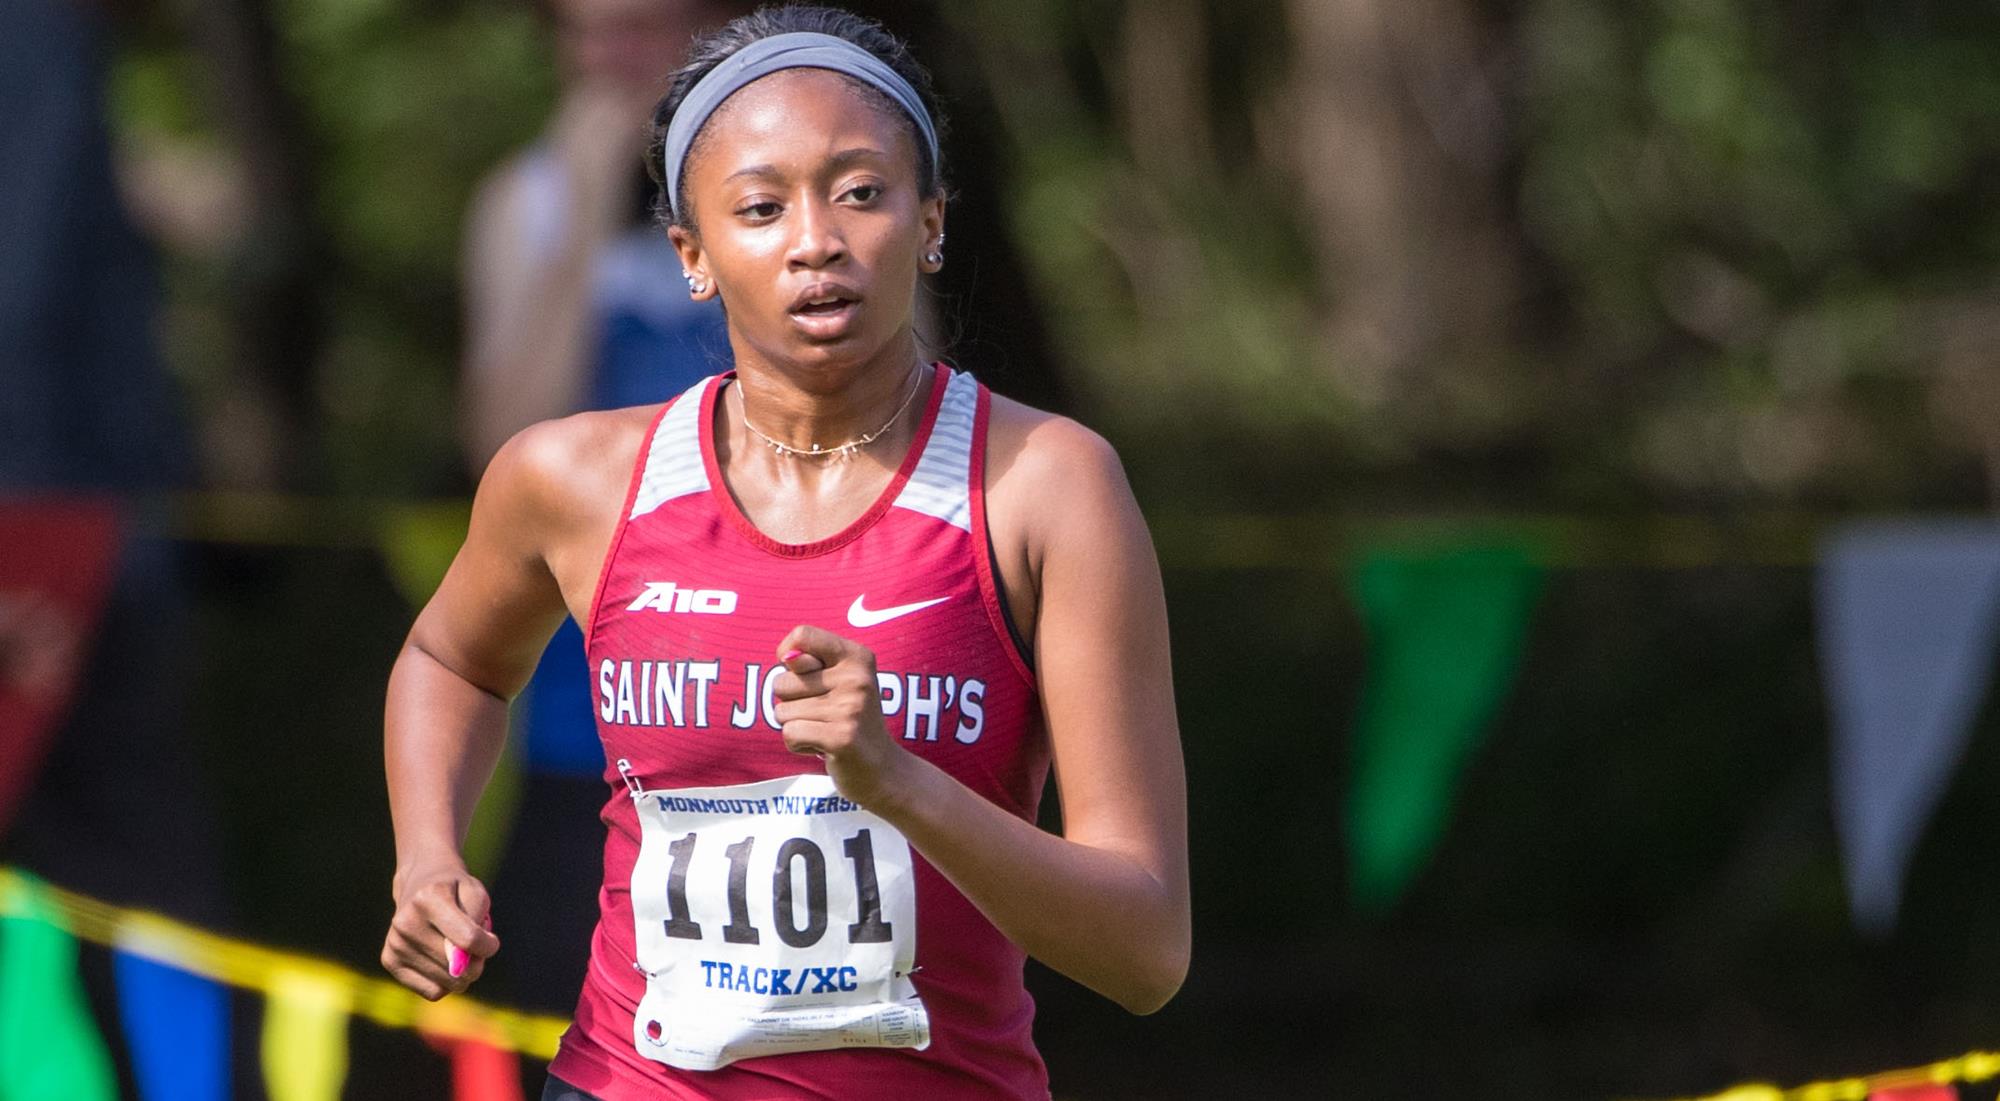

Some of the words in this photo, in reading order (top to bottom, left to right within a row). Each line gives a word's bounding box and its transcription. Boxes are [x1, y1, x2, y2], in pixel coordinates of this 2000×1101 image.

[626, 582, 738, 614] A10
[600, 657, 720, 729] SAINT
[731, 664, 987, 745] JOPH'S
[657, 796, 769, 814] MONMOUTH
[772, 796, 860, 815] UNIVERSI
[663, 828, 893, 948] 1101
[700, 960, 858, 995] TRACK/XC
